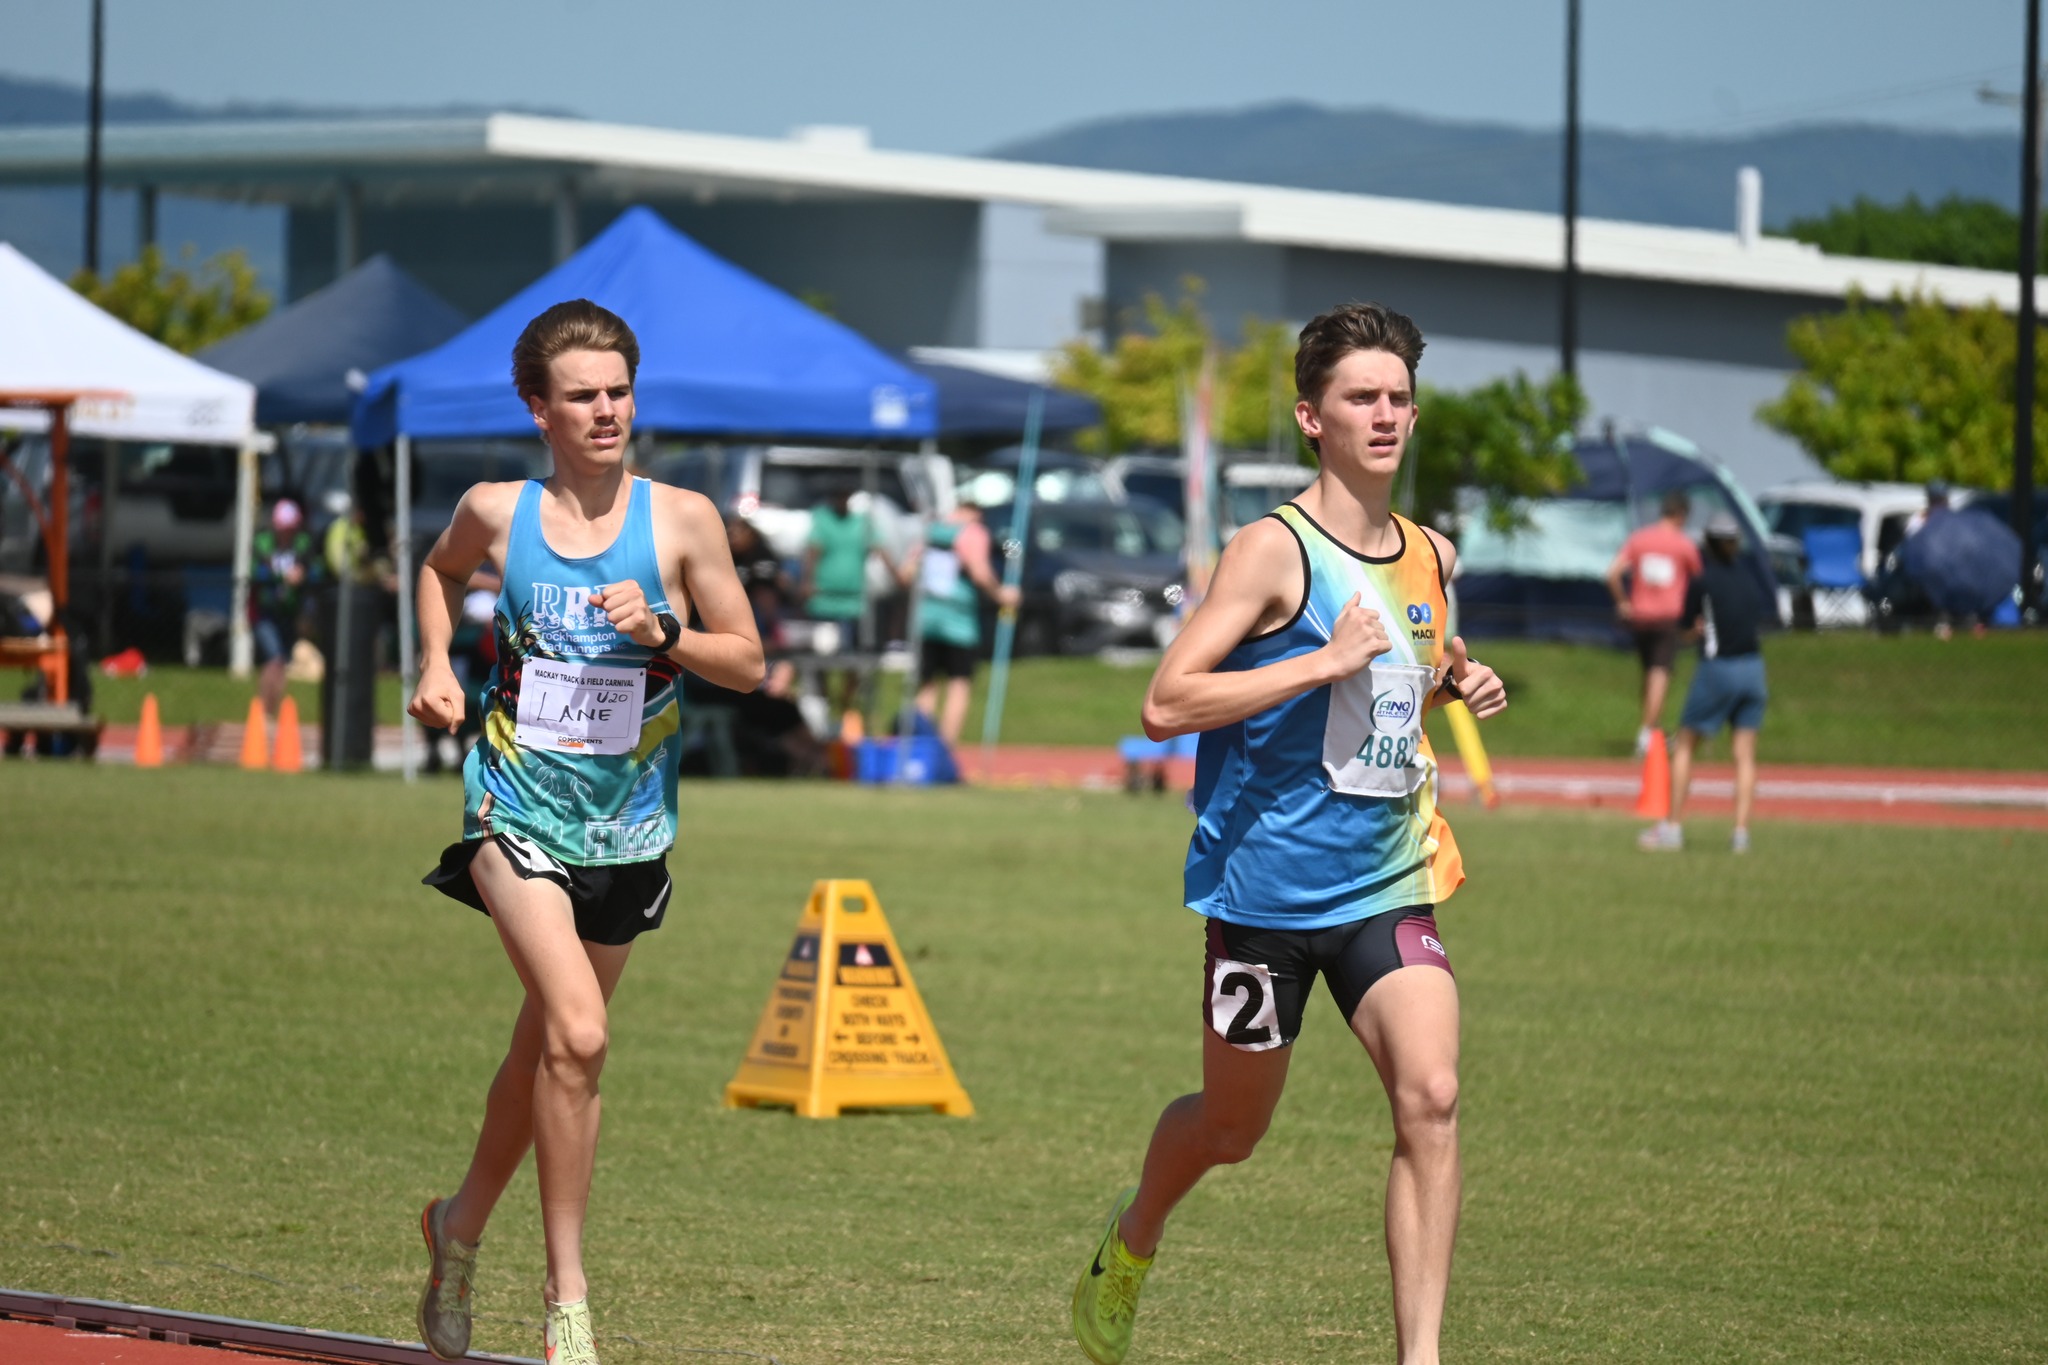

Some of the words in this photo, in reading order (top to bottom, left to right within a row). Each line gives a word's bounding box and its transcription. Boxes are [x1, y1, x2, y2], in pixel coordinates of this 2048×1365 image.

[541, 631, 617, 644] rockhampton
[564, 643, 612, 654] runners
[535, 669, 559, 680] MACKAY
[560, 673, 580, 684] TRACK
[580, 677, 586, 685] &
[586, 677, 604, 686] FIELD
[604, 678, 635, 687] CARNIVAL
[596, 691, 629, 704] U20
[536, 691, 613, 723] LANE
[557, 735, 603, 745] COMPONENTS
[1356, 734, 1417, 769] 4882
[1219, 971, 1272, 1045] 2
